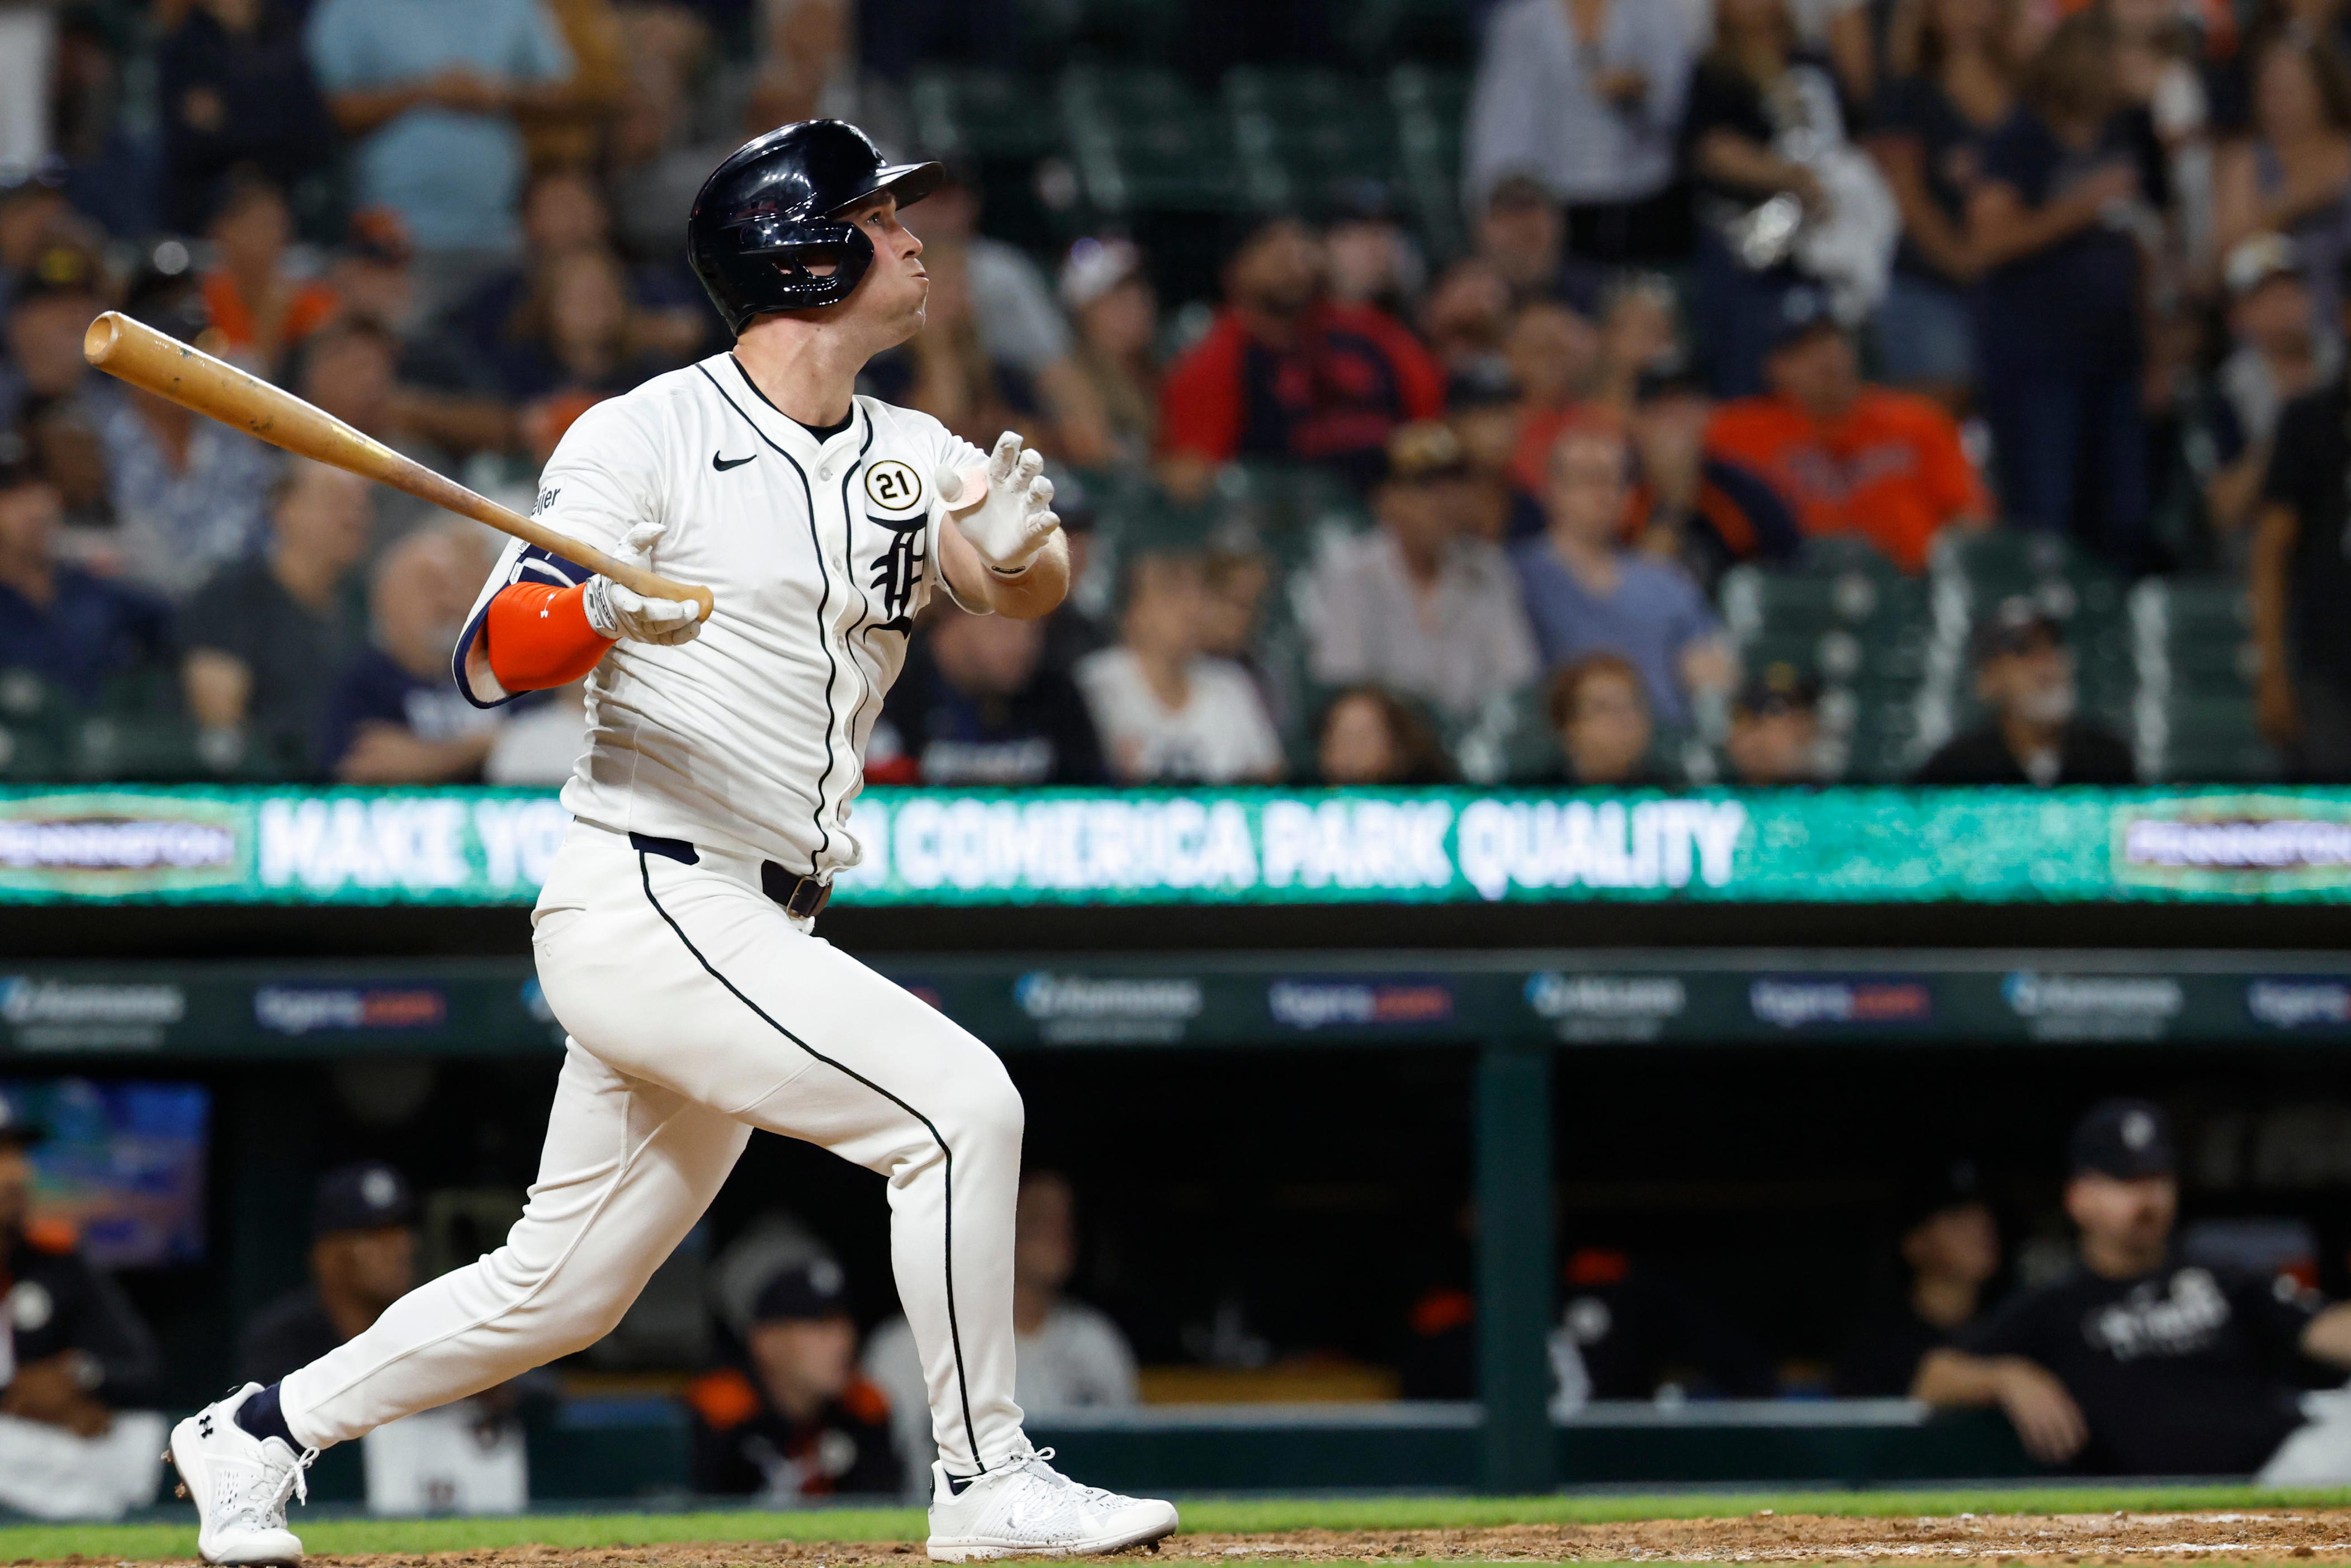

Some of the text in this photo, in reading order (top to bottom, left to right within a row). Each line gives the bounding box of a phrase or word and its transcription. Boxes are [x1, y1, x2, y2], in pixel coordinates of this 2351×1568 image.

[876, 470, 910, 499] 21
[531, 486, 561, 516] eijer
[259, 798, 471, 888] MAKE
[476, 798, 573, 888] YO
[896, 798, 1257, 889] COMERICA
[1262, 799, 1450, 889] PARK
[1458, 798, 1744, 901] QUALITY
